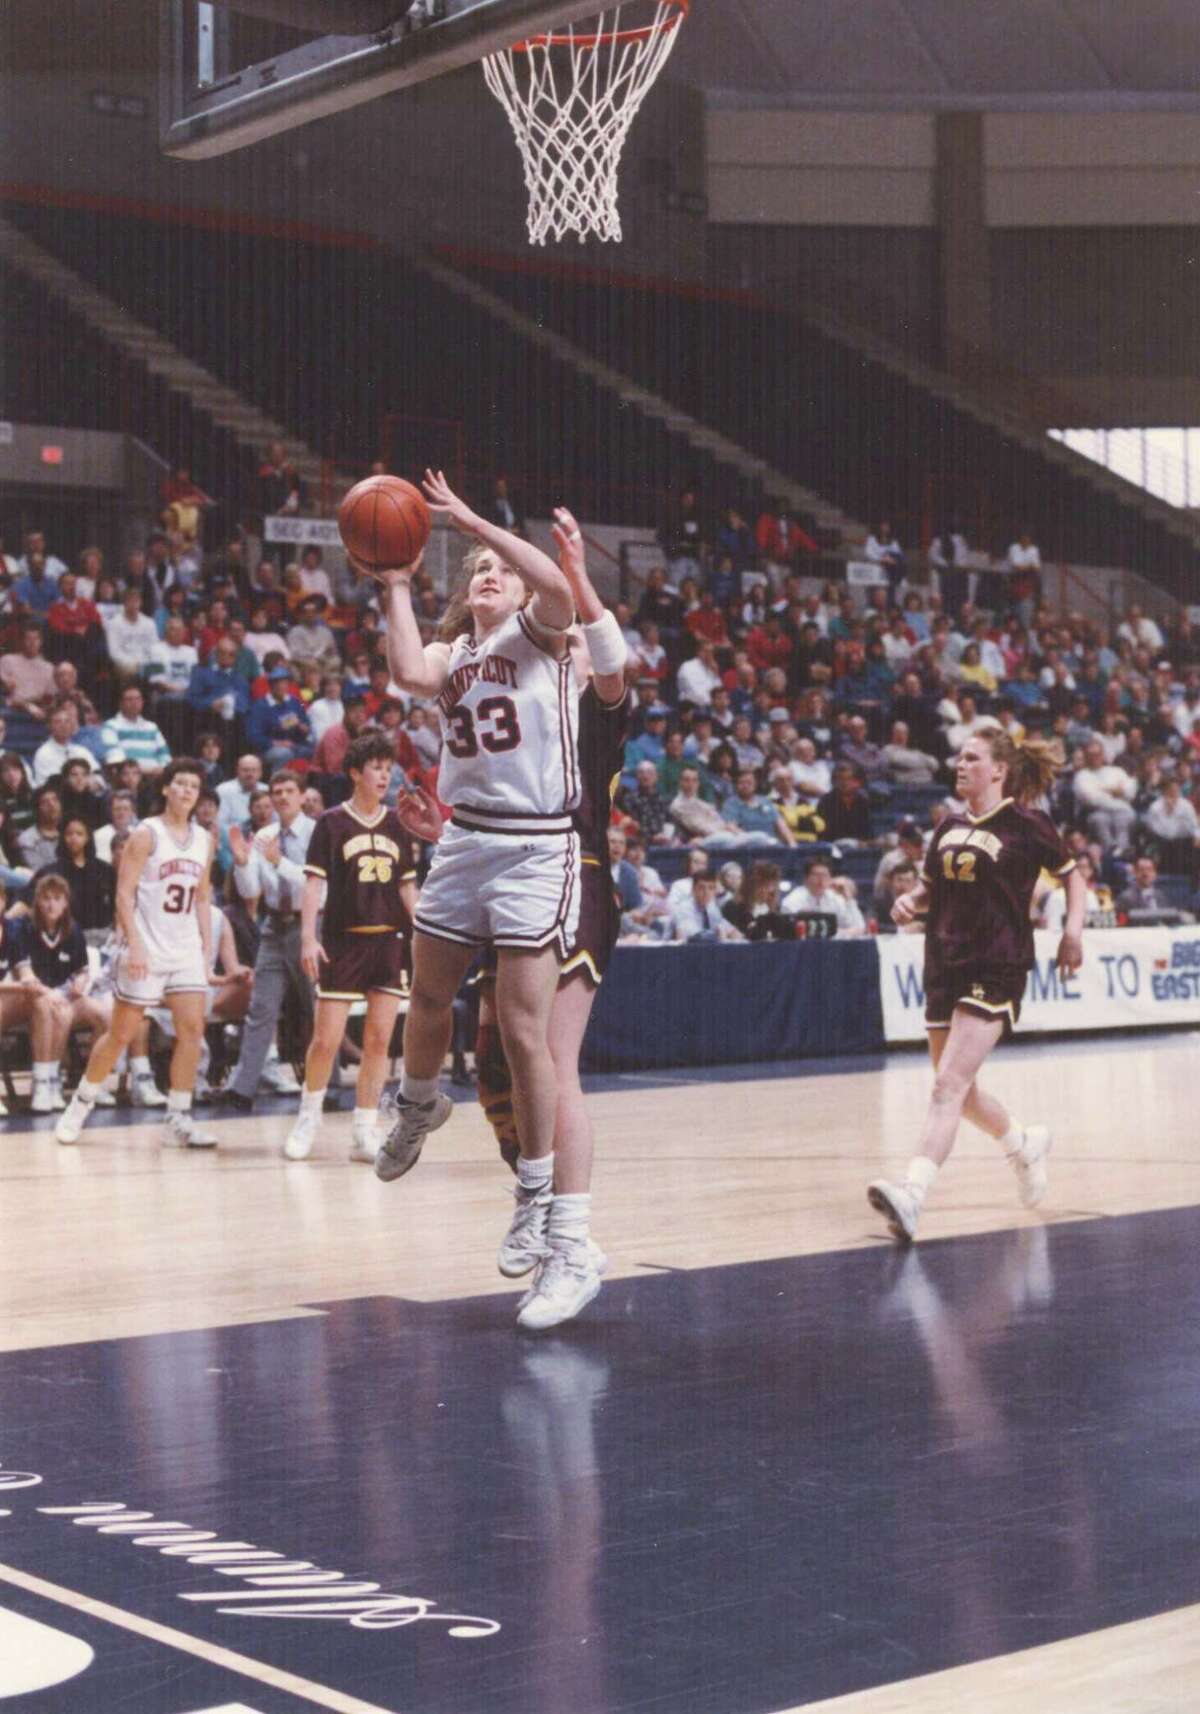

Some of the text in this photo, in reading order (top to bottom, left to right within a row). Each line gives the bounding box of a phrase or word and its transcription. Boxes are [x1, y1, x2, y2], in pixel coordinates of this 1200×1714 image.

[445, 695, 522, 759] 33
[357, 855, 393, 883] 25
[943, 850, 976, 882] 12
[163, 884, 196, 915] 31
[1099, 954, 1139, 998] TO
[1151, 972, 1200, 1001] EAST
